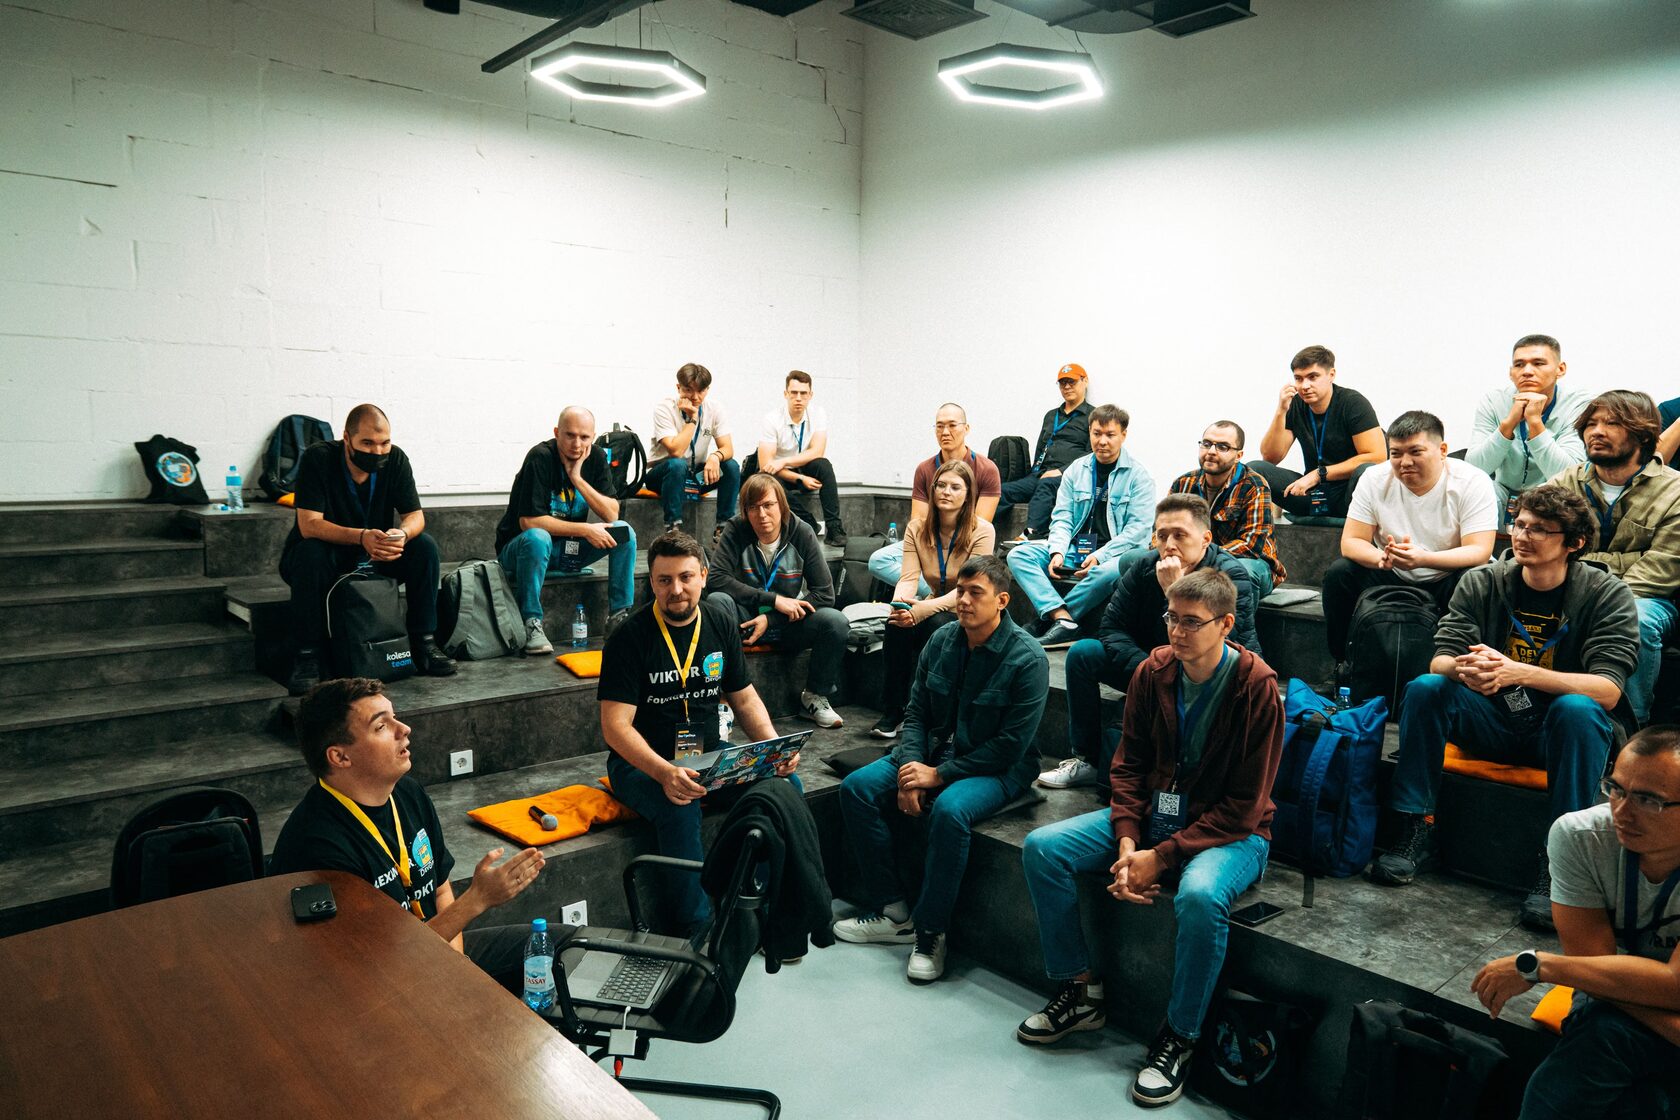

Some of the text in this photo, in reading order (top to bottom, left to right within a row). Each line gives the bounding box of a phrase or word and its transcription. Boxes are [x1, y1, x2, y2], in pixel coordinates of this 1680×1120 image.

[386, 651, 411, 661] kolesa
[391, 658, 412, 668] team
[649, 666, 700, 684] VIKTR
[693, 688, 706, 698] of
[414, 880, 434, 900] DKT
